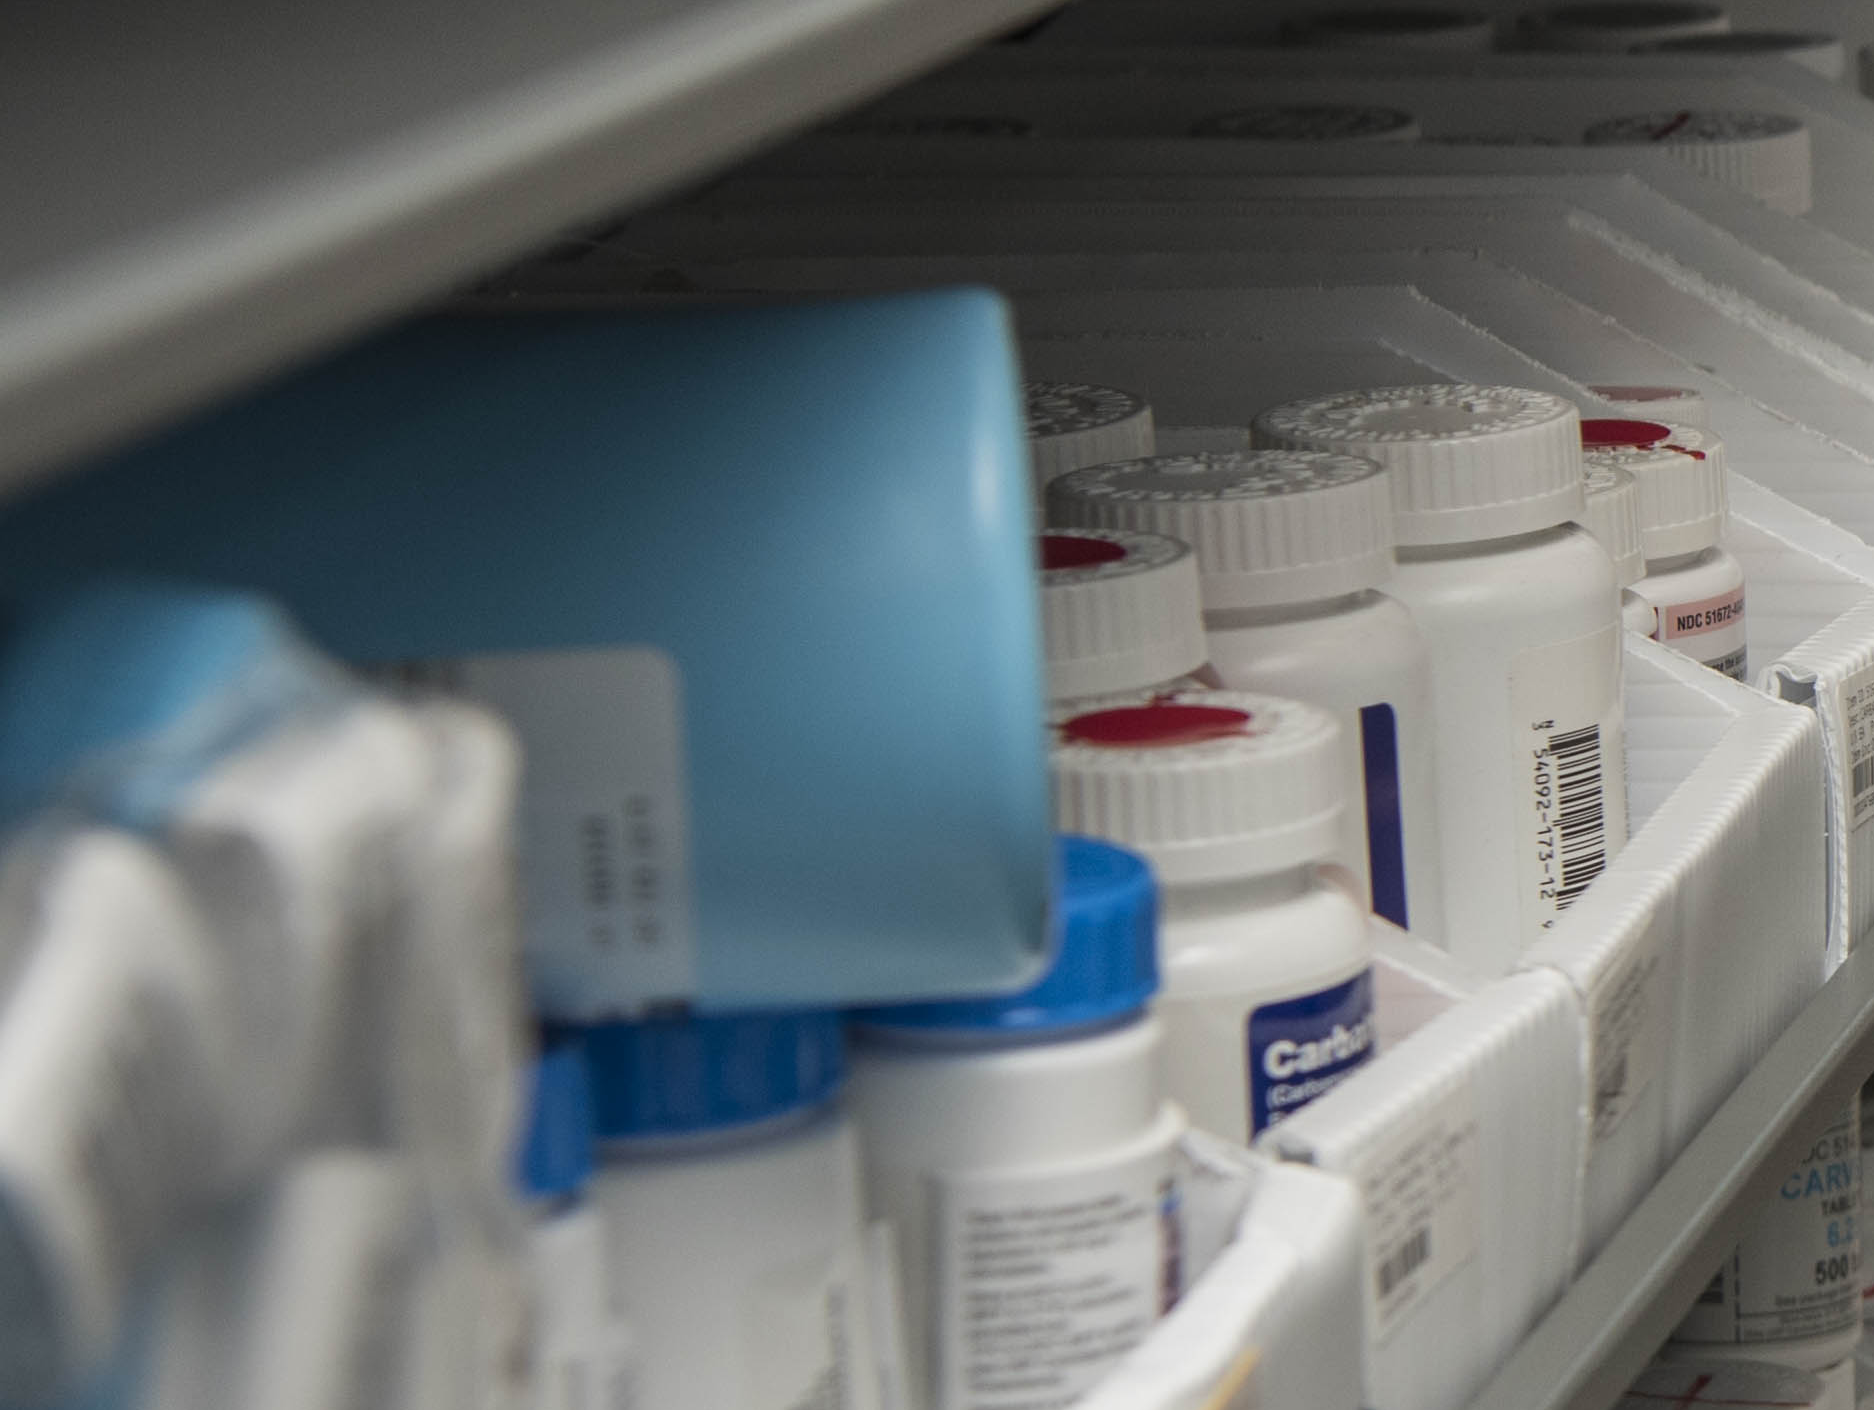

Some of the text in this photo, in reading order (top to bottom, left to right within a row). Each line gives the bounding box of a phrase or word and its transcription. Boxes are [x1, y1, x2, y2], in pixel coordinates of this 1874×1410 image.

[1677, 612, 1702, 632] NDC
[1533, 747, 1558, 900] 54092-173-12
[1814, 1255, 1849, 1285] 500
